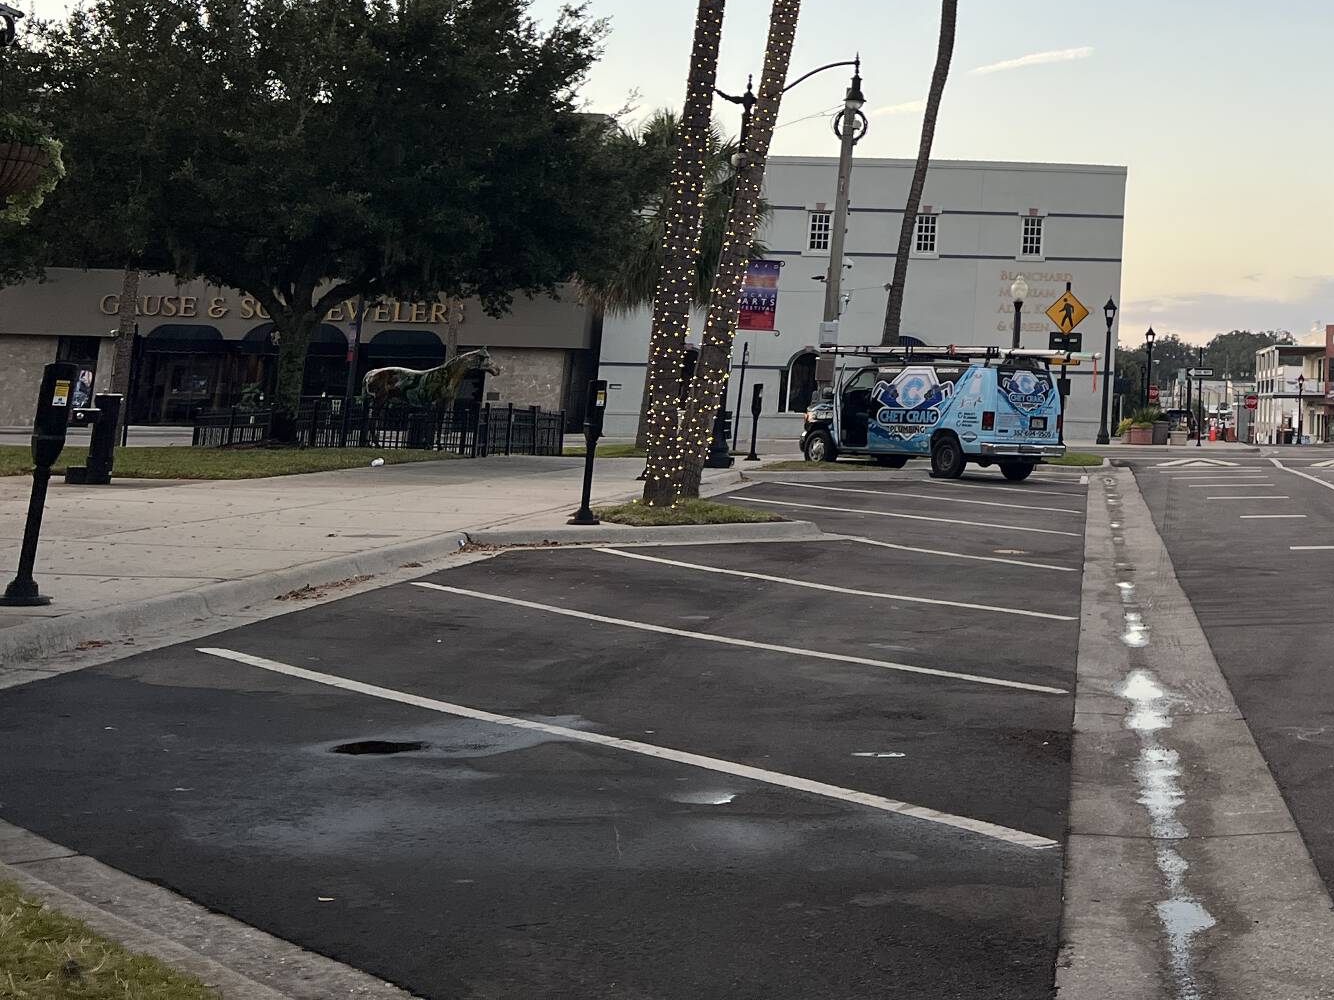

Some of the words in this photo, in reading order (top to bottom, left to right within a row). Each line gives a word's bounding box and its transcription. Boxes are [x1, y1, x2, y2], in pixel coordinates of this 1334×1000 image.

[100, 294, 198, 318] GUSE
[207, 297, 229, 318] &
[742, 298, 775, 306] ARTS
[879, 411, 903, 424] CHET
[906, 412, 938, 425] CRAIG
[889, 426, 925, 434] PLUMBING
